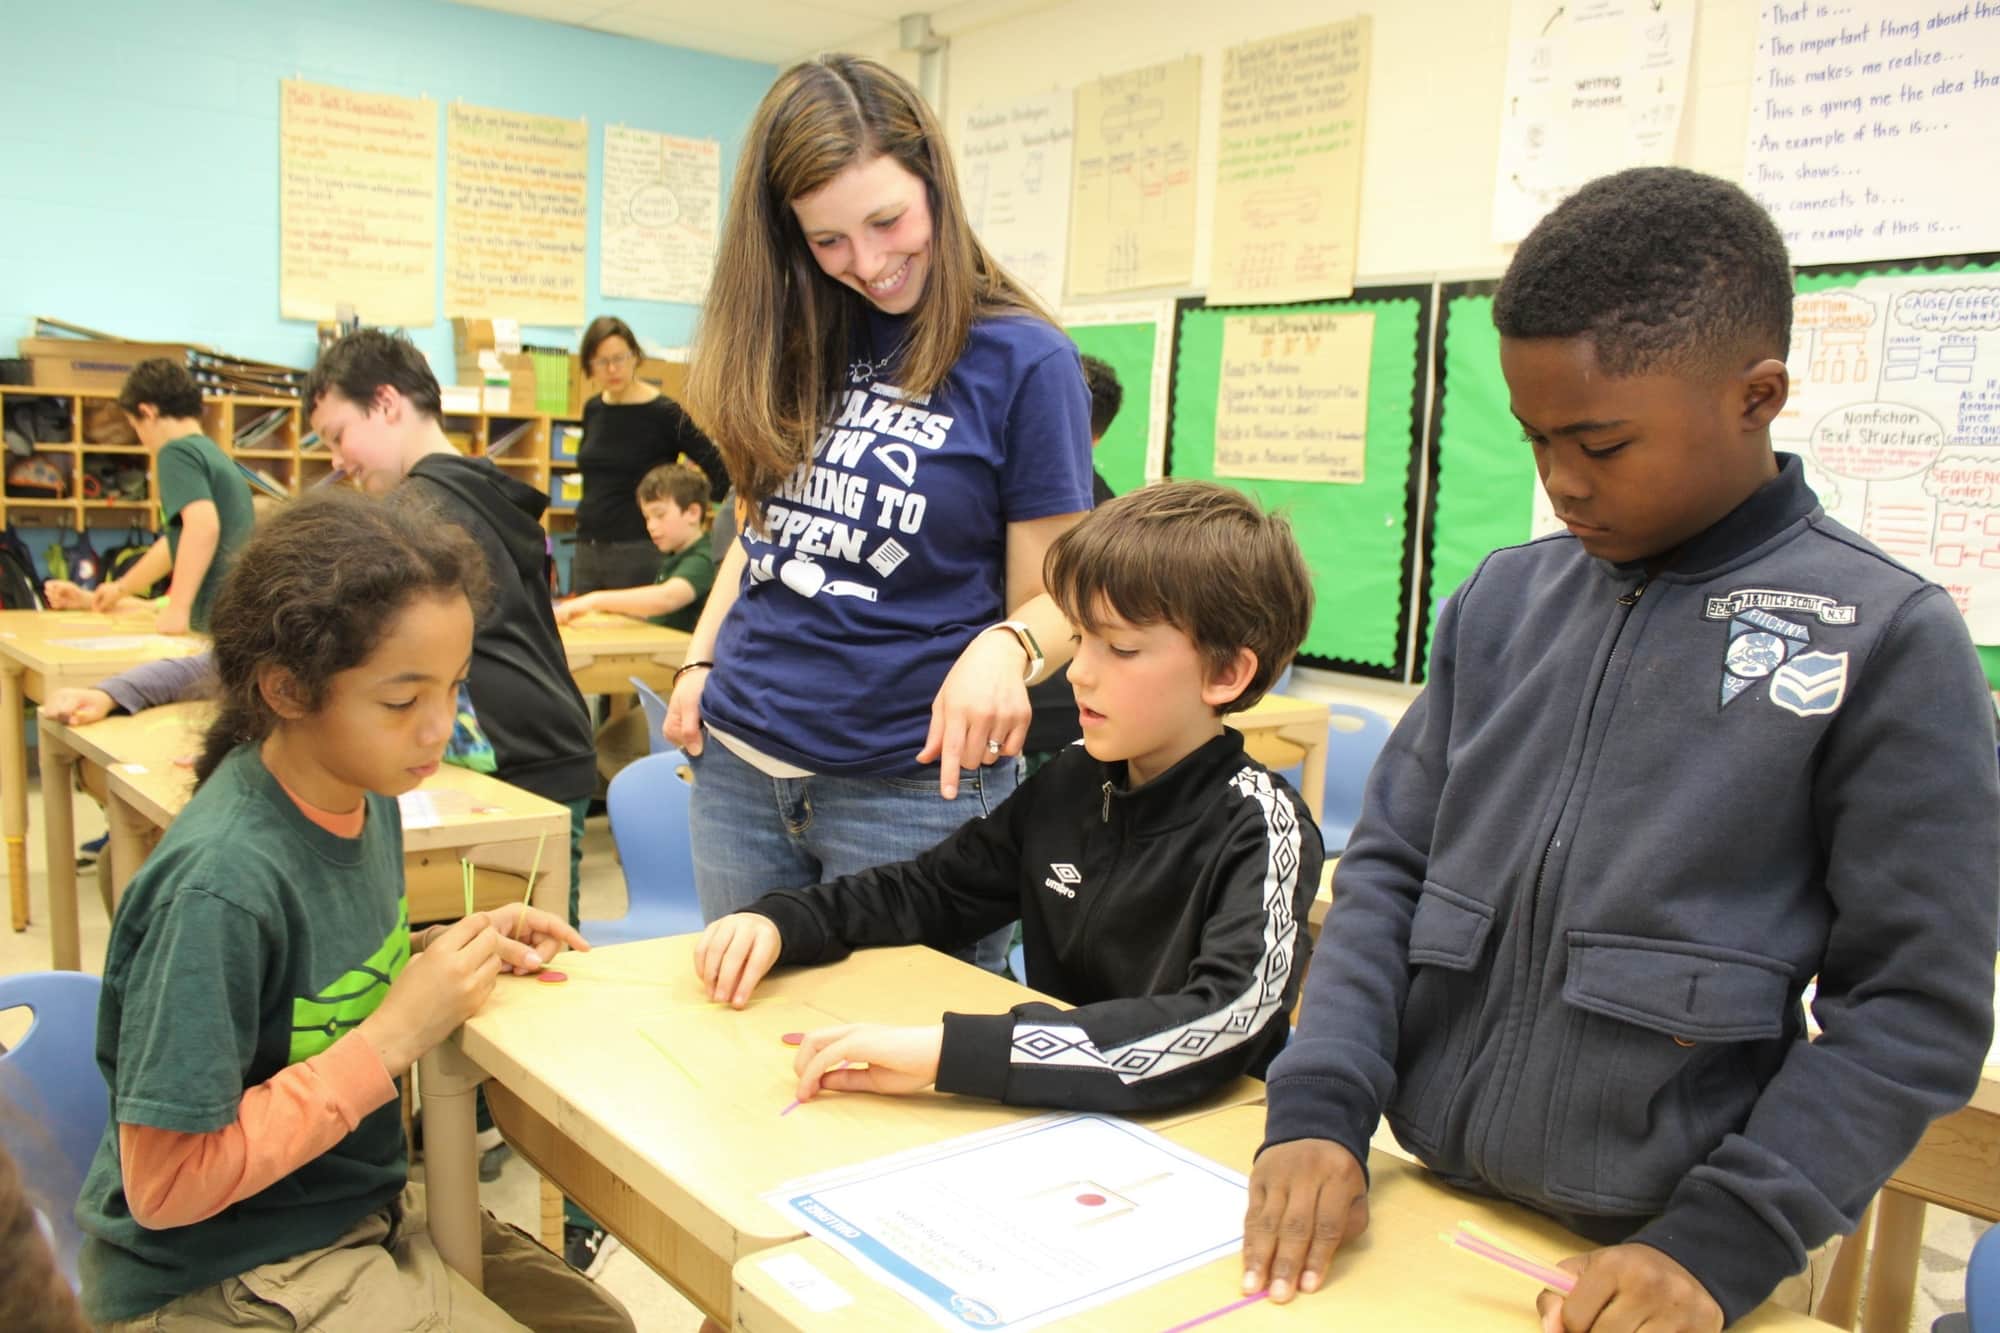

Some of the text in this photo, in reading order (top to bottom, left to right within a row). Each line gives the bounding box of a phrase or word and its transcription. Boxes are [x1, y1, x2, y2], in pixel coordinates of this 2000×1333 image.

[1773, 1, 1808, 24] That
[1771, 36, 1794, 56] The
[1800, 22, 1869, 55] important
[1880, 19, 1920, 39] thing
[1926, 5, 1968, 30] about
[1768, 67, 1795, 87] This
[1805, 64, 1853, 83] makes
[1862, 63, 1881, 74] me
[1766, 98, 1793, 120] This
[1802, 105, 1813, 116] is
[1821, 96, 1861, 118] giving
[1870, 95, 1891, 105] me
[1900, 82, 1923, 102] the
[1932, 79, 1964, 96] idea
[1760, 133, 1779, 151] An
[1786, 129, 1845, 150] example
[1854, 123, 1866, 141] of
[1874, 122, 1900, 138] this
[1758, 163, 1784, 182] This
[1790, 189, 1855, 211] connects
[1812, 225, 1864, 243] example
[1873, 221, 1886, 236] of
[1893, 221, 1920, 235] this
[1889, 334, 1977, 344] cause effect
[836, 389, 954, 450] AKES
[1843, 408, 1920, 425] Nonfiction
[1820, 427, 1940, 447] Text Structures
[1940, 485, 1993, 500] (order)
[877, 484, 926, 534] TO
[1790, 598, 1819, 611] SCOUT
[1723, 677, 1745, 693] 92
[1045, 877, 1075, 899] umbro
